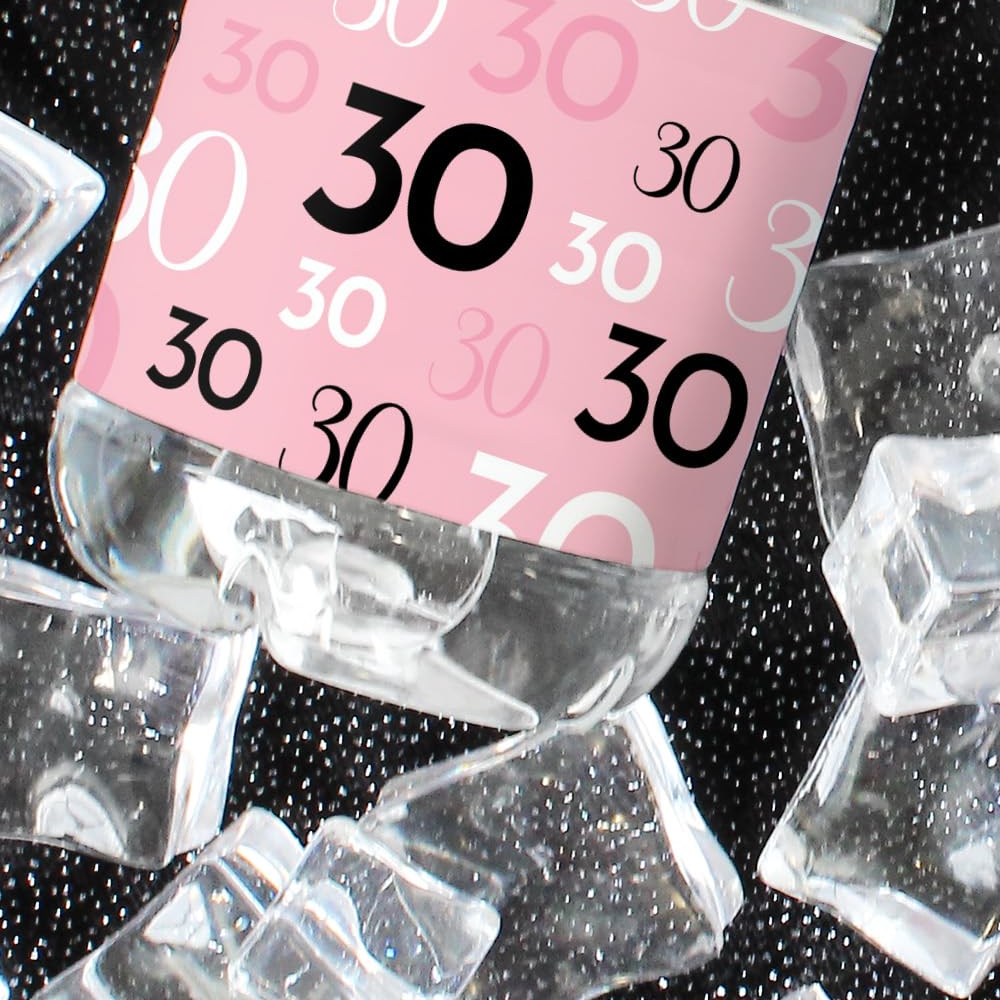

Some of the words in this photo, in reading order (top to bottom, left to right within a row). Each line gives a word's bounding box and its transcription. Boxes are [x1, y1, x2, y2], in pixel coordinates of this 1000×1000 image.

[202, 18, 320, 114] 30
[302, 82, 534, 272] 30
[633, 121, 741, 213] 30
[277, 256, 387, 348] 30
[548, 211, 662, 303] 30
[146, 305, 263, 411] 30
[428, 307, 550, 418] 30
[574, 322, 748, 469] 30
[279, 385, 413, 502] 30
